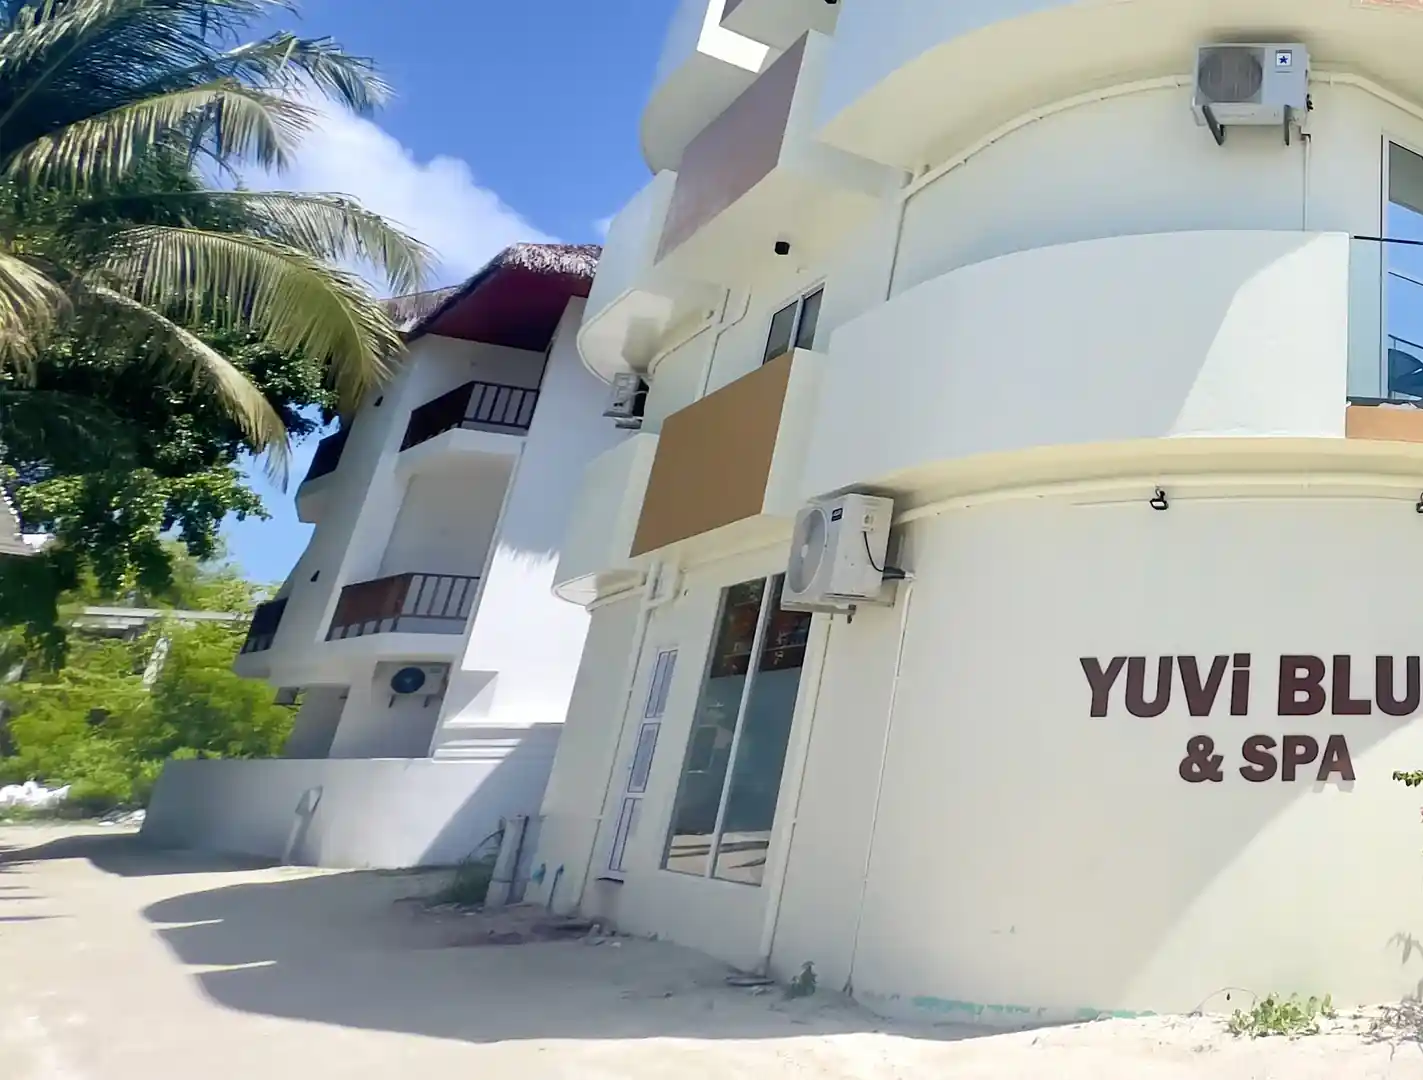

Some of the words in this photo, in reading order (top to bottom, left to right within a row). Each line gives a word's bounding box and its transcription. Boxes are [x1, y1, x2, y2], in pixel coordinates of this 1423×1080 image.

[1080, 653, 1251, 718] YUVi
[1179, 734, 1224, 783] &
[1239, 734, 1356, 782] SPA
